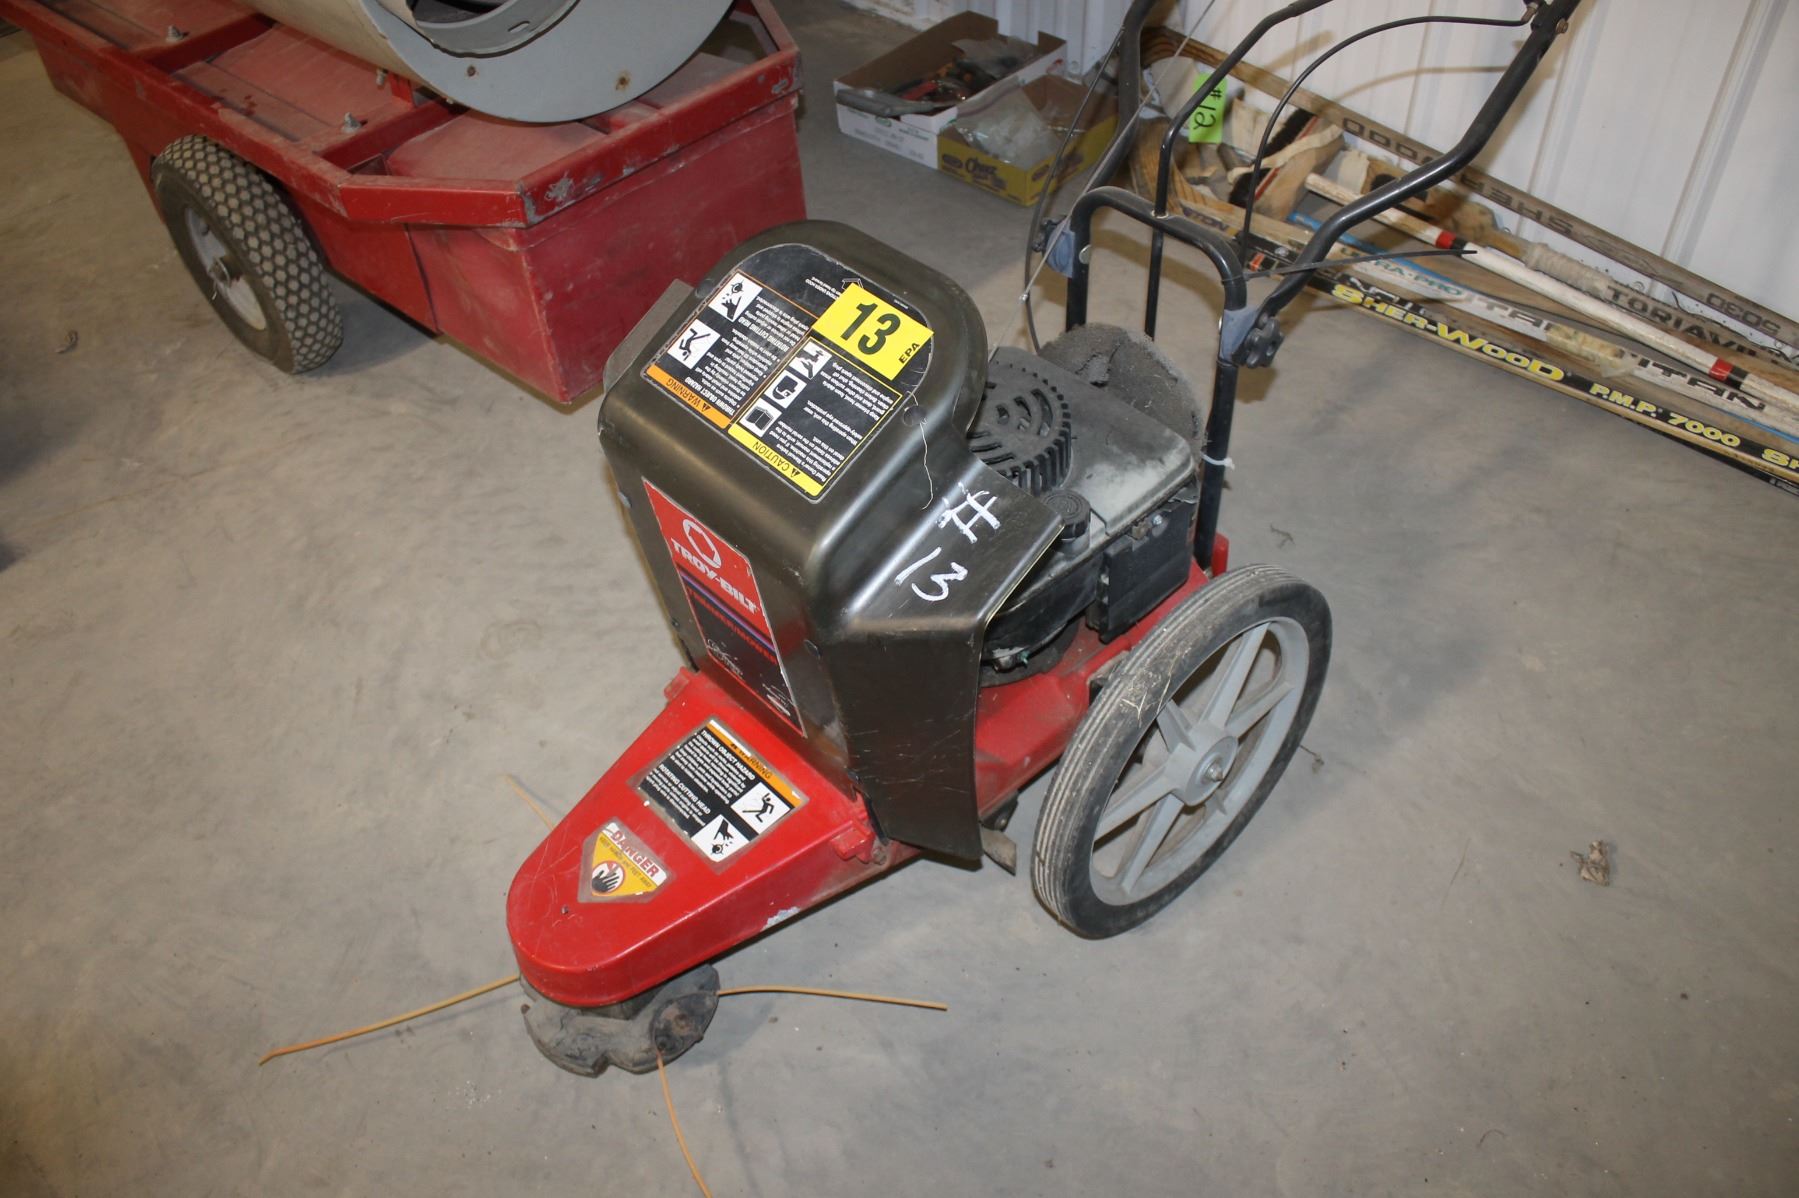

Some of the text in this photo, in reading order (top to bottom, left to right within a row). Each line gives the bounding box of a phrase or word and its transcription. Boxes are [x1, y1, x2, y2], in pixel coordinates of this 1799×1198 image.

[840, 303, 901, 355] 13
[899, 342, 920, 364] EPA
[666, 378, 703, 410] WARNING
[684, 376, 735, 415] THROWN OBJECT HAZARD
[1667, 412, 1741, 447] 7000
[752, 441, 791, 471] CAUTION
[936, 482, 1000, 543] #
[670, 537, 758, 614] TROY-BILT
[700, 730, 756, 780] THROWN OBJECT HAZARD
[657, 764, 711, 814] ROTATING CUTTING HEAD
[611, 830, 660, 878] DANGER
